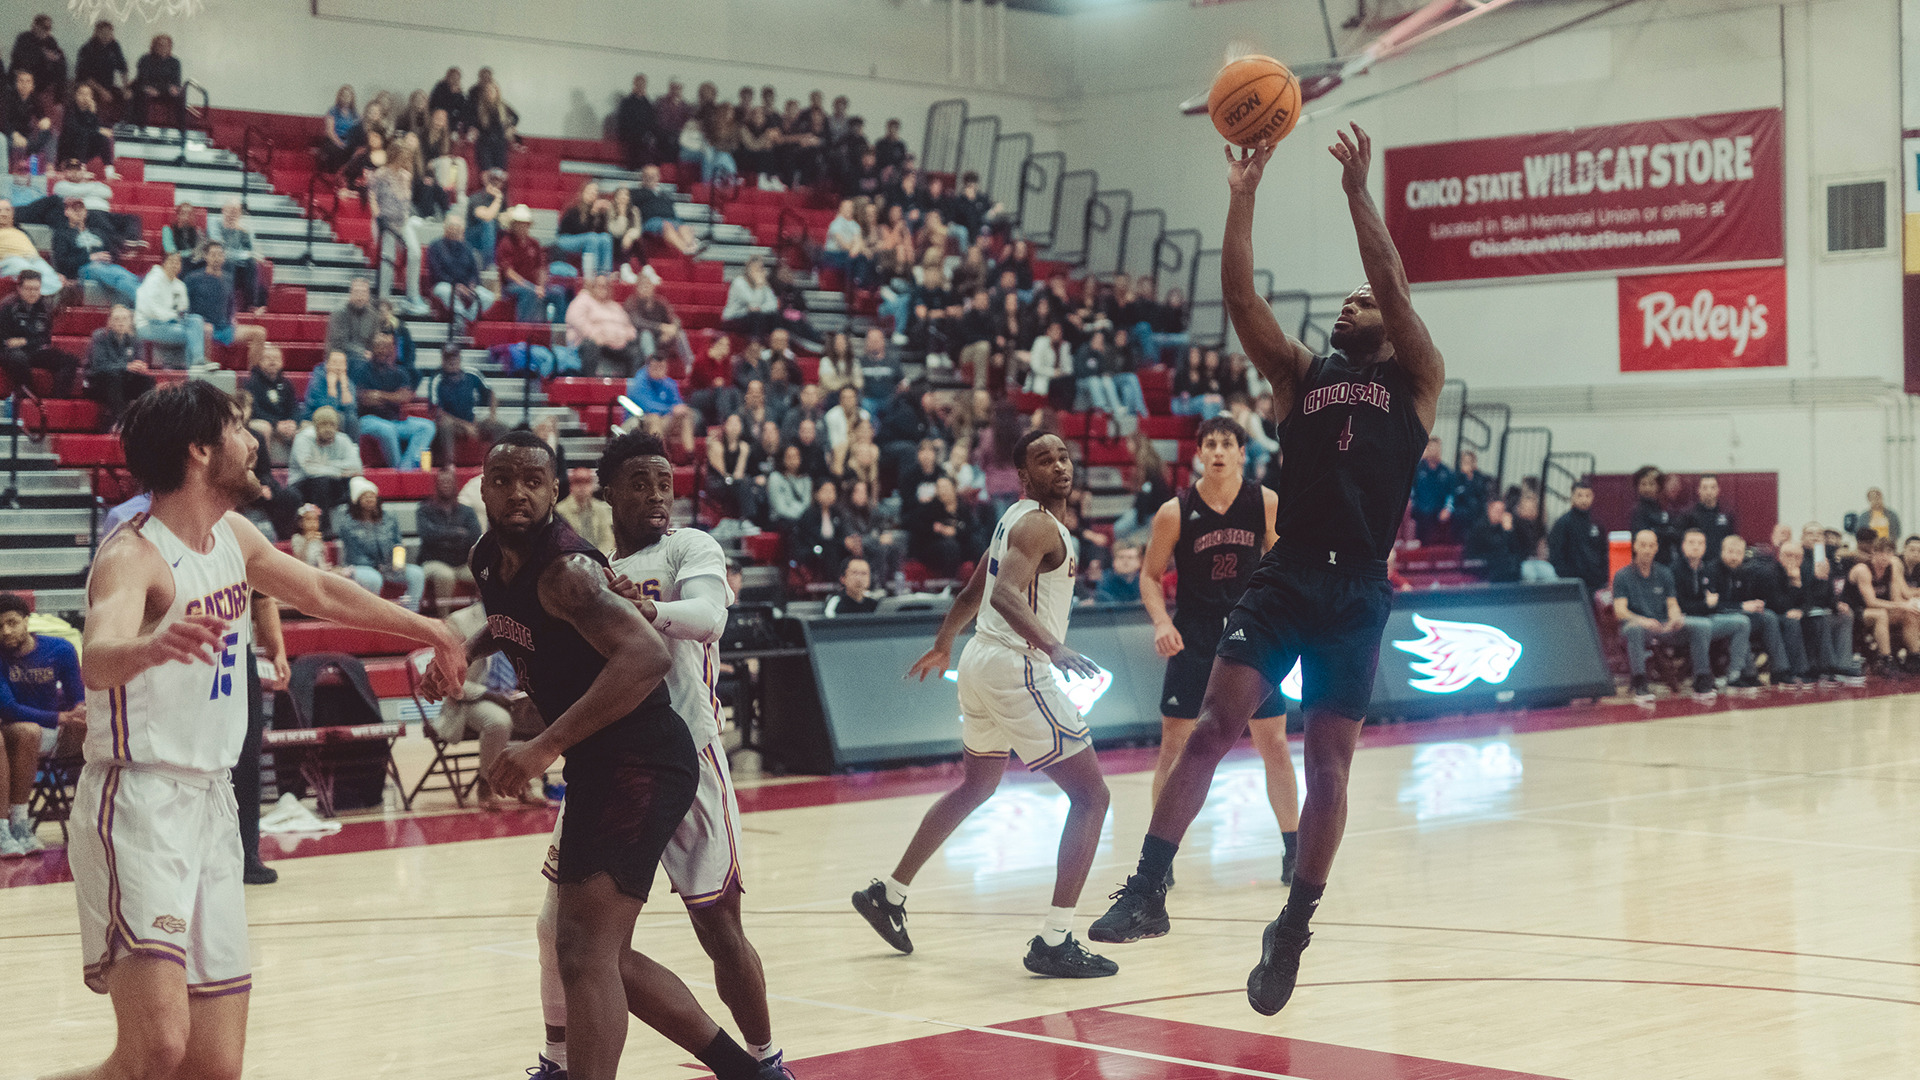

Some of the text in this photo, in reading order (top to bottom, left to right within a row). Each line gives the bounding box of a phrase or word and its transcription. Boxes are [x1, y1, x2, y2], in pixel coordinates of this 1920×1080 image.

[1224, 92, 1262, 127] NCAA
[1405, 134, 1754, 210] CHICO STATE WILDCAT STORE
[1429, 219, 1484, 241] Located
[1484, 217, 1499, 234] in
[1529, 207, 1595, 231] Memorial
[1597, 204, 1641, 226] Union
[1642, 206, 1659, 223] or
[1660, 200, 1708, 222] online
[1709, 200, 1726, 217] at
[1637, 288, 1769, 357] Raley's
[1303, 381, 1391, 415] CHICO STATE
[1336, 415, 1353, 450] 4
[1193, 527, 1255, 554] CHICO STATE
[1211, 553, 1238, 580] 22
